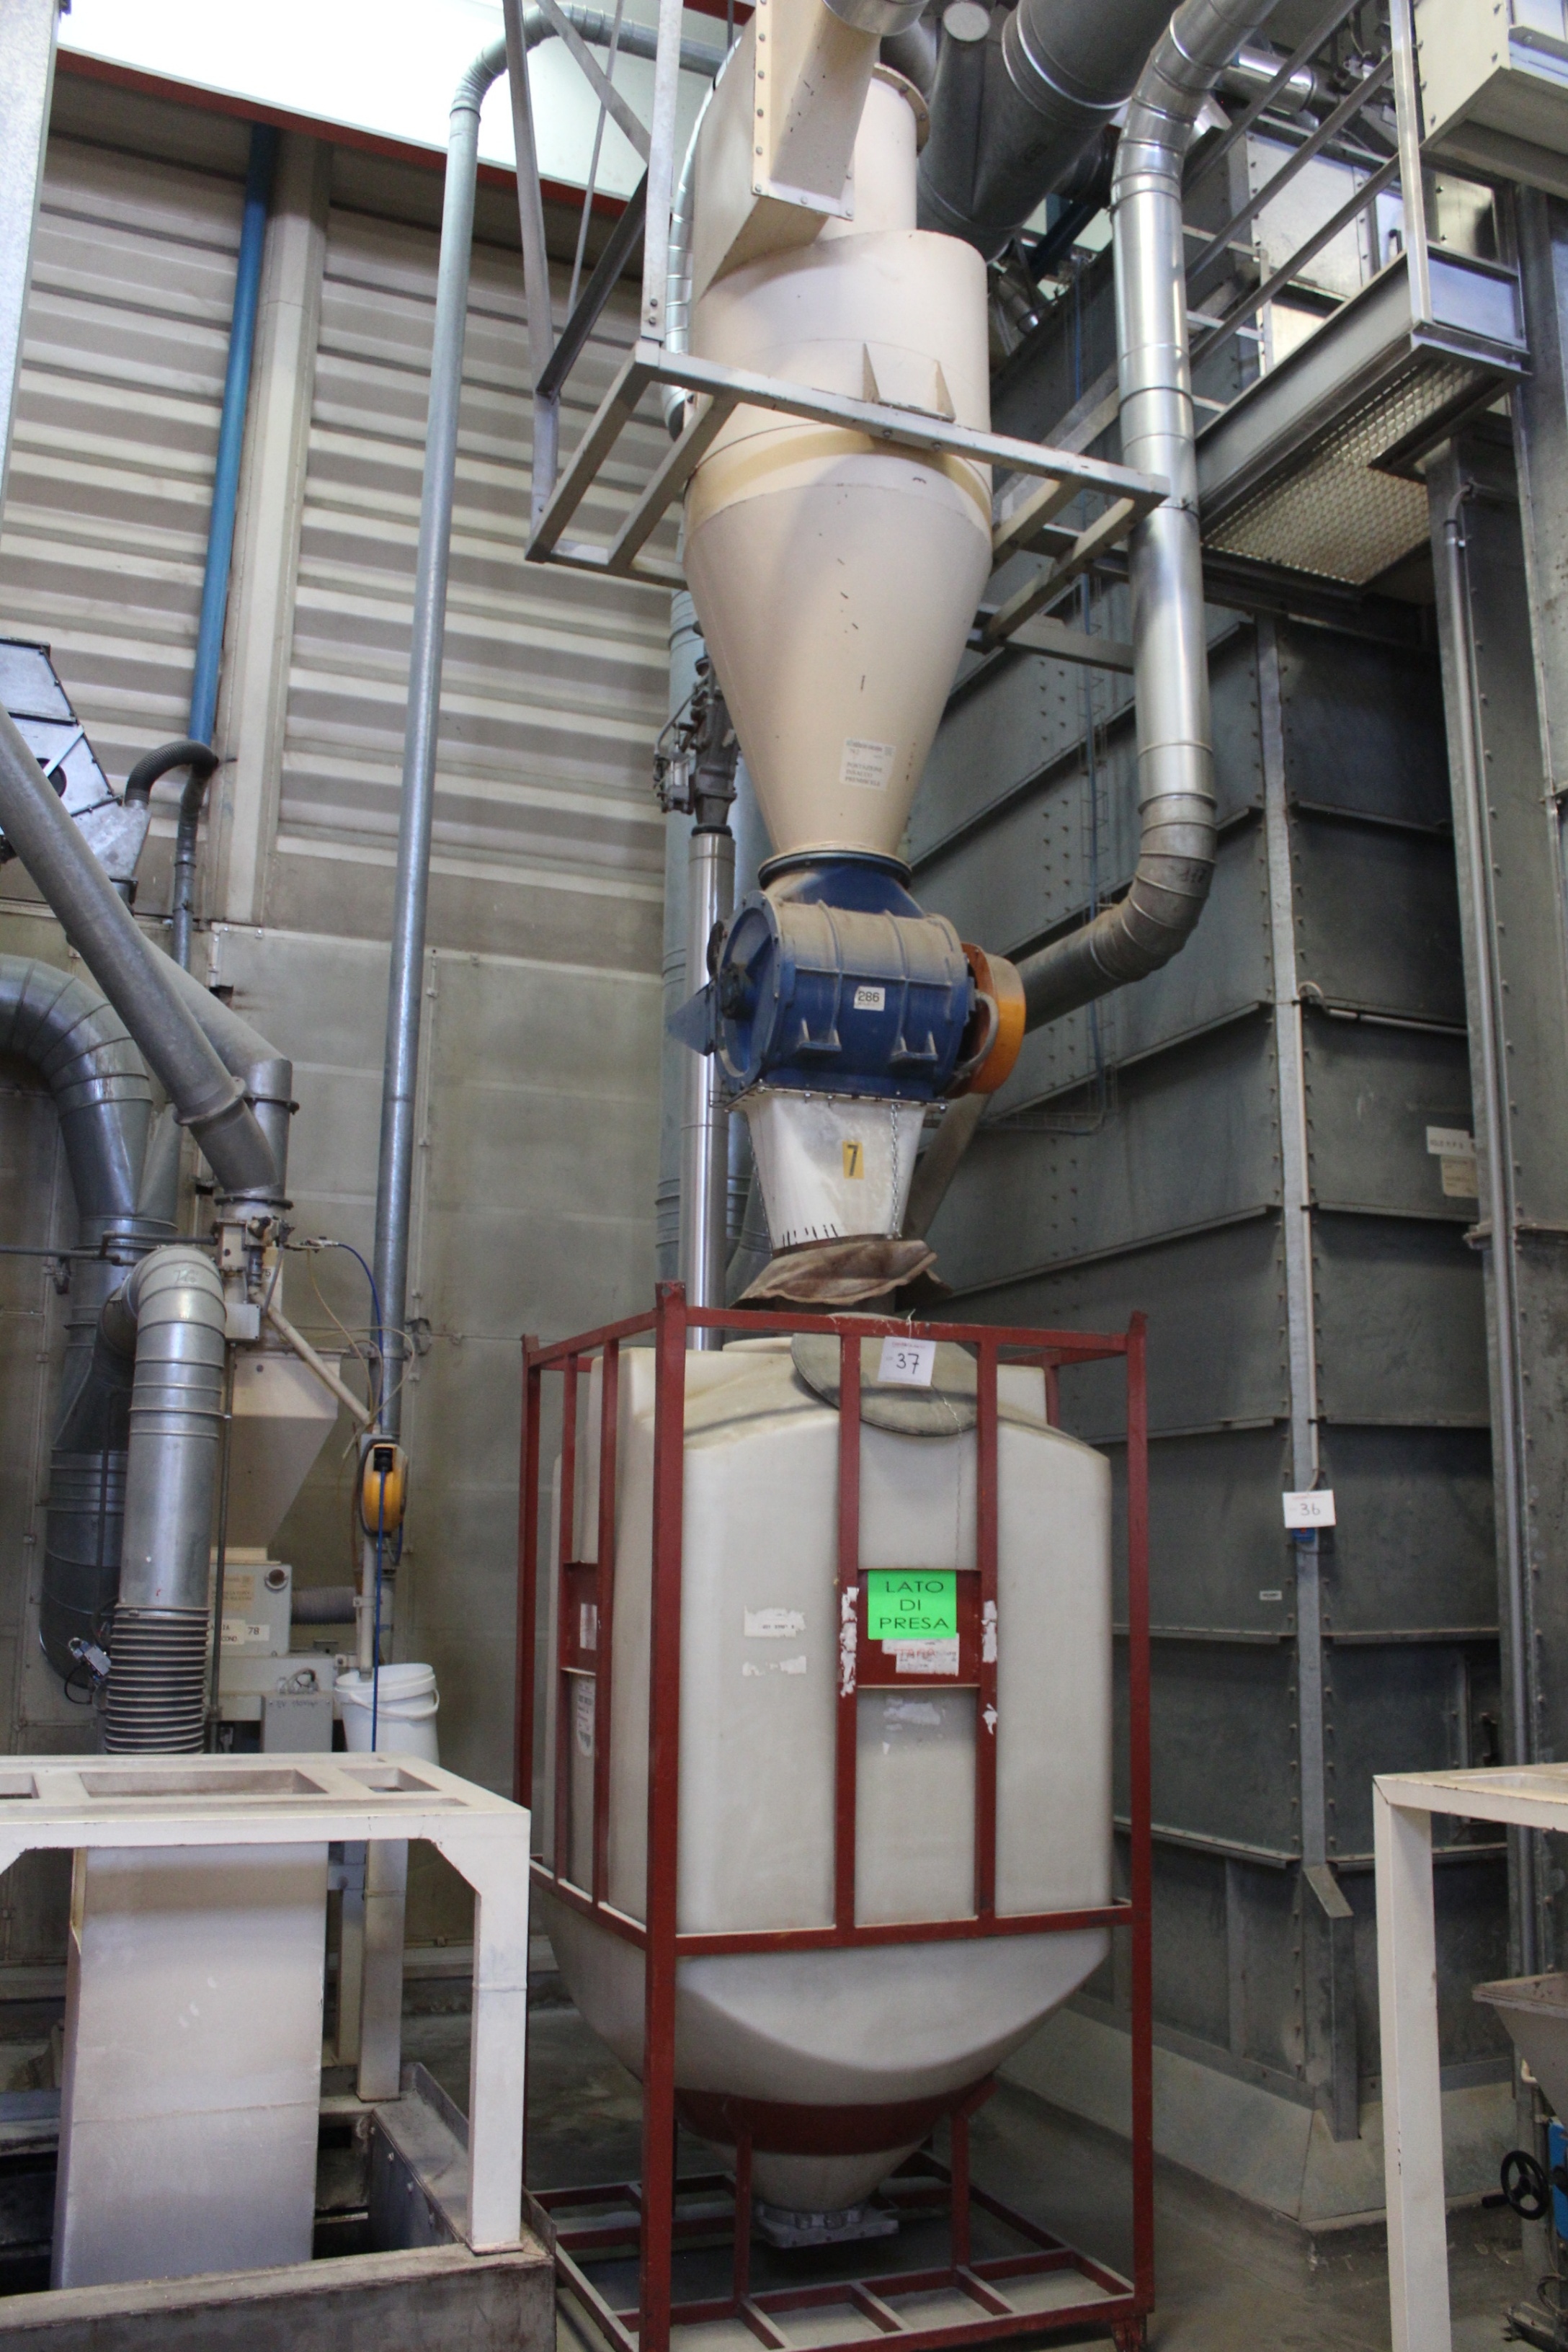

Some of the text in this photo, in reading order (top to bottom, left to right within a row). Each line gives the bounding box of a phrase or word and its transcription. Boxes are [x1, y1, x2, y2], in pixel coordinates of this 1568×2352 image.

[858, 991, 880, 1002] 286
[847, 1144, 858, 1176] 7
[896, 1353, 919, 1375] 37
[1299, 1502, 1321, 1516] 36
[886, 1580, 944, 1593] LATO
[900, 1599, 921, 1611] DI
[880, 1617, 949, 1629] PRESA
[248, 1626, 259, 1635] 78
